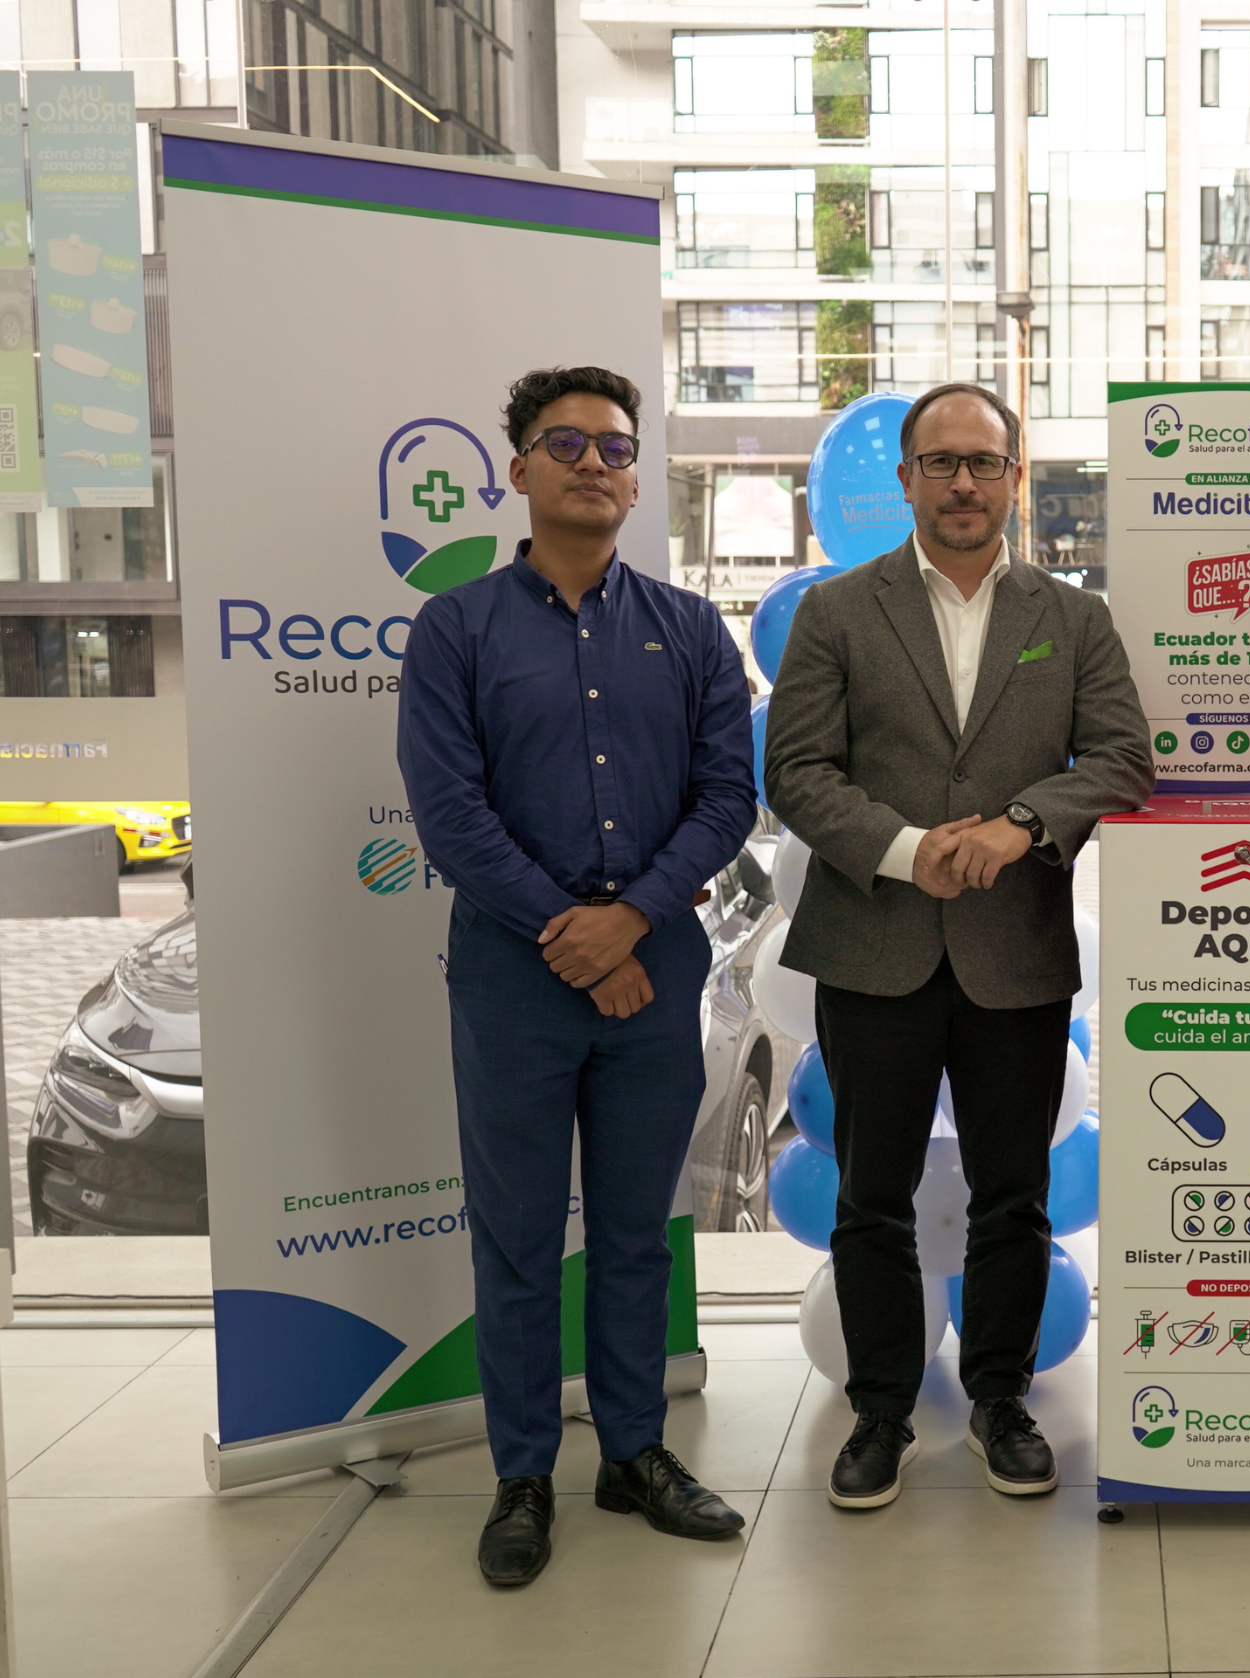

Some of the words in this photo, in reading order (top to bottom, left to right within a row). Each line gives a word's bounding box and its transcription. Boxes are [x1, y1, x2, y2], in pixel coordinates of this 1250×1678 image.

[1189, 445, 1213, 453] Salud
[1216, 446, 1235, 454] para
[1238, 445, 1245, 453] el
[1191, 475, 1204, 483] EN
[1206, 475, 1248, 483] ALIANZA
[838, 490, 900, 505] Farmacias
[842, 503, 911, 525] Medicit
[219, 599, 413, 660] Reco
[1154, 632, 1236, 647] Ecuador
[1169, 651, 1210, 666] más
[1216, 651, 1241, 666] de
[274, 669, 357, 694] Salud
[367, 675, 400, 699] pa
[1181, 694, 1233, 705] como
[1199, 713, 1248, 724] SÍGUENOS
[1127, 978, 1157, 992] Tus
[1162, 1009, 1230, 1025] “Cuida
[1154, 1029, 1205, 1044] cuida
[1210, 1029, 1227, 1044] el
[1147, 1157, 1228, 1174] Cápsulas
[284, 1178, 430, 1213] Encuentranos
[1125, 1250, 1182, 1264] Blister
[1201, 1283, 1217, 1293] NO
[1186, 1433, 1215, 1443] Salud
[1218, 1435, 1241, 1445] para
[1187, 1458, 1211, 1468] Una
